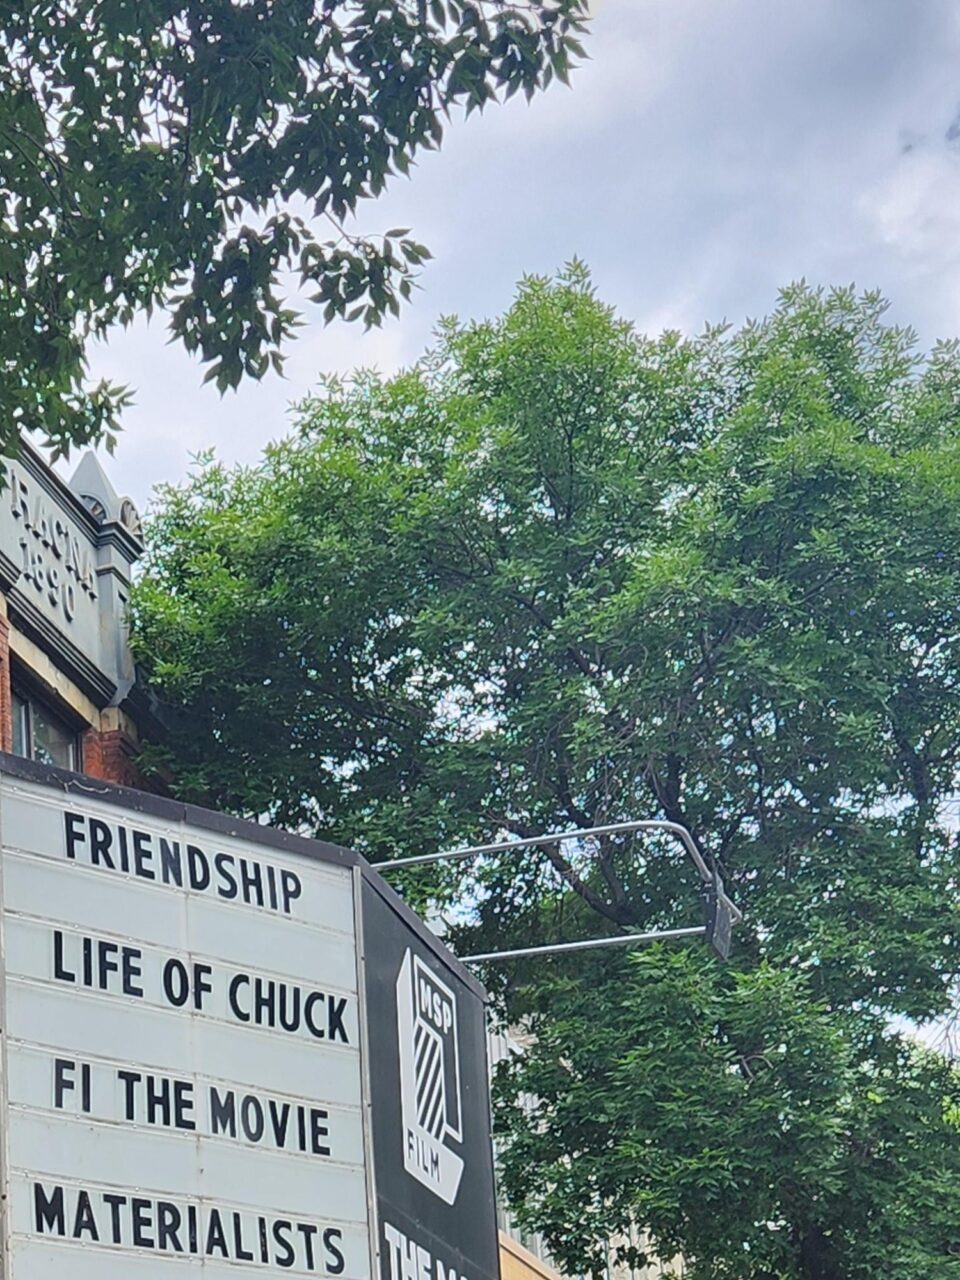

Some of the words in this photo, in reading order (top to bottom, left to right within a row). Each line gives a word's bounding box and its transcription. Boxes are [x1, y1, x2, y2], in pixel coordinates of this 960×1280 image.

[0, 455, 98, 601] RACNA
[63, 810, 302, 914] FRIENDSHIP
[53, 930, 144, 998] LIFE
[162, 958, 213, 1011] OF
[228, 973, 350, 1044] CHUCK
[419, 977, 453, 1034] MSP
[117, 1069, 196, 1131] THE
[209, 1086, 331, 1157] MOVIE
[406, 1127, 441, 1183] FILM
[33, 1182, 345, 1275] MATERIALISTS
